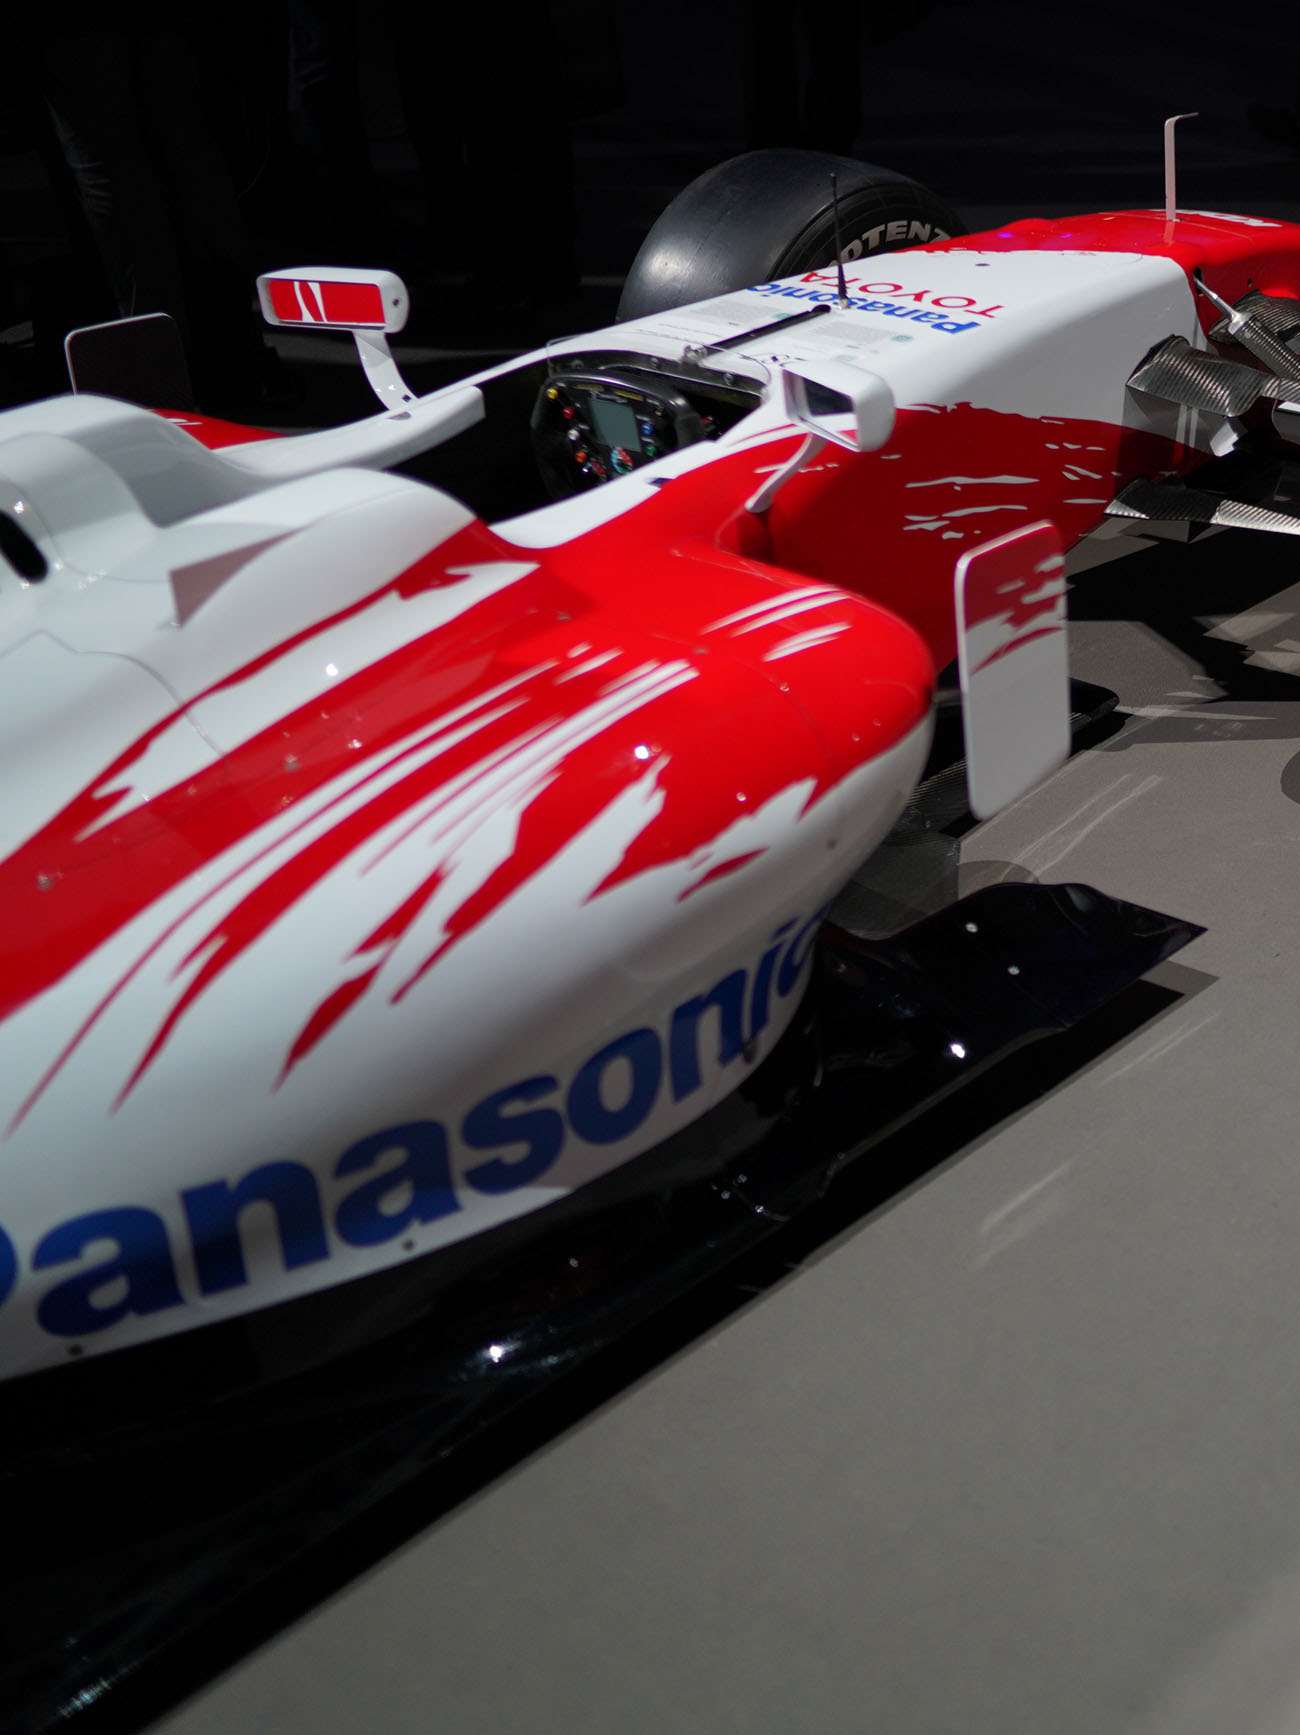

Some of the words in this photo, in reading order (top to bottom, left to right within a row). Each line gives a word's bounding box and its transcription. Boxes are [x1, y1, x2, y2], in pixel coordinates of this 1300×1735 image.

[828, 220, 950, 268] OTENZ
[748, 283, 981, 334] Panasonic
[0, 898, 833, 1337] anasonic
